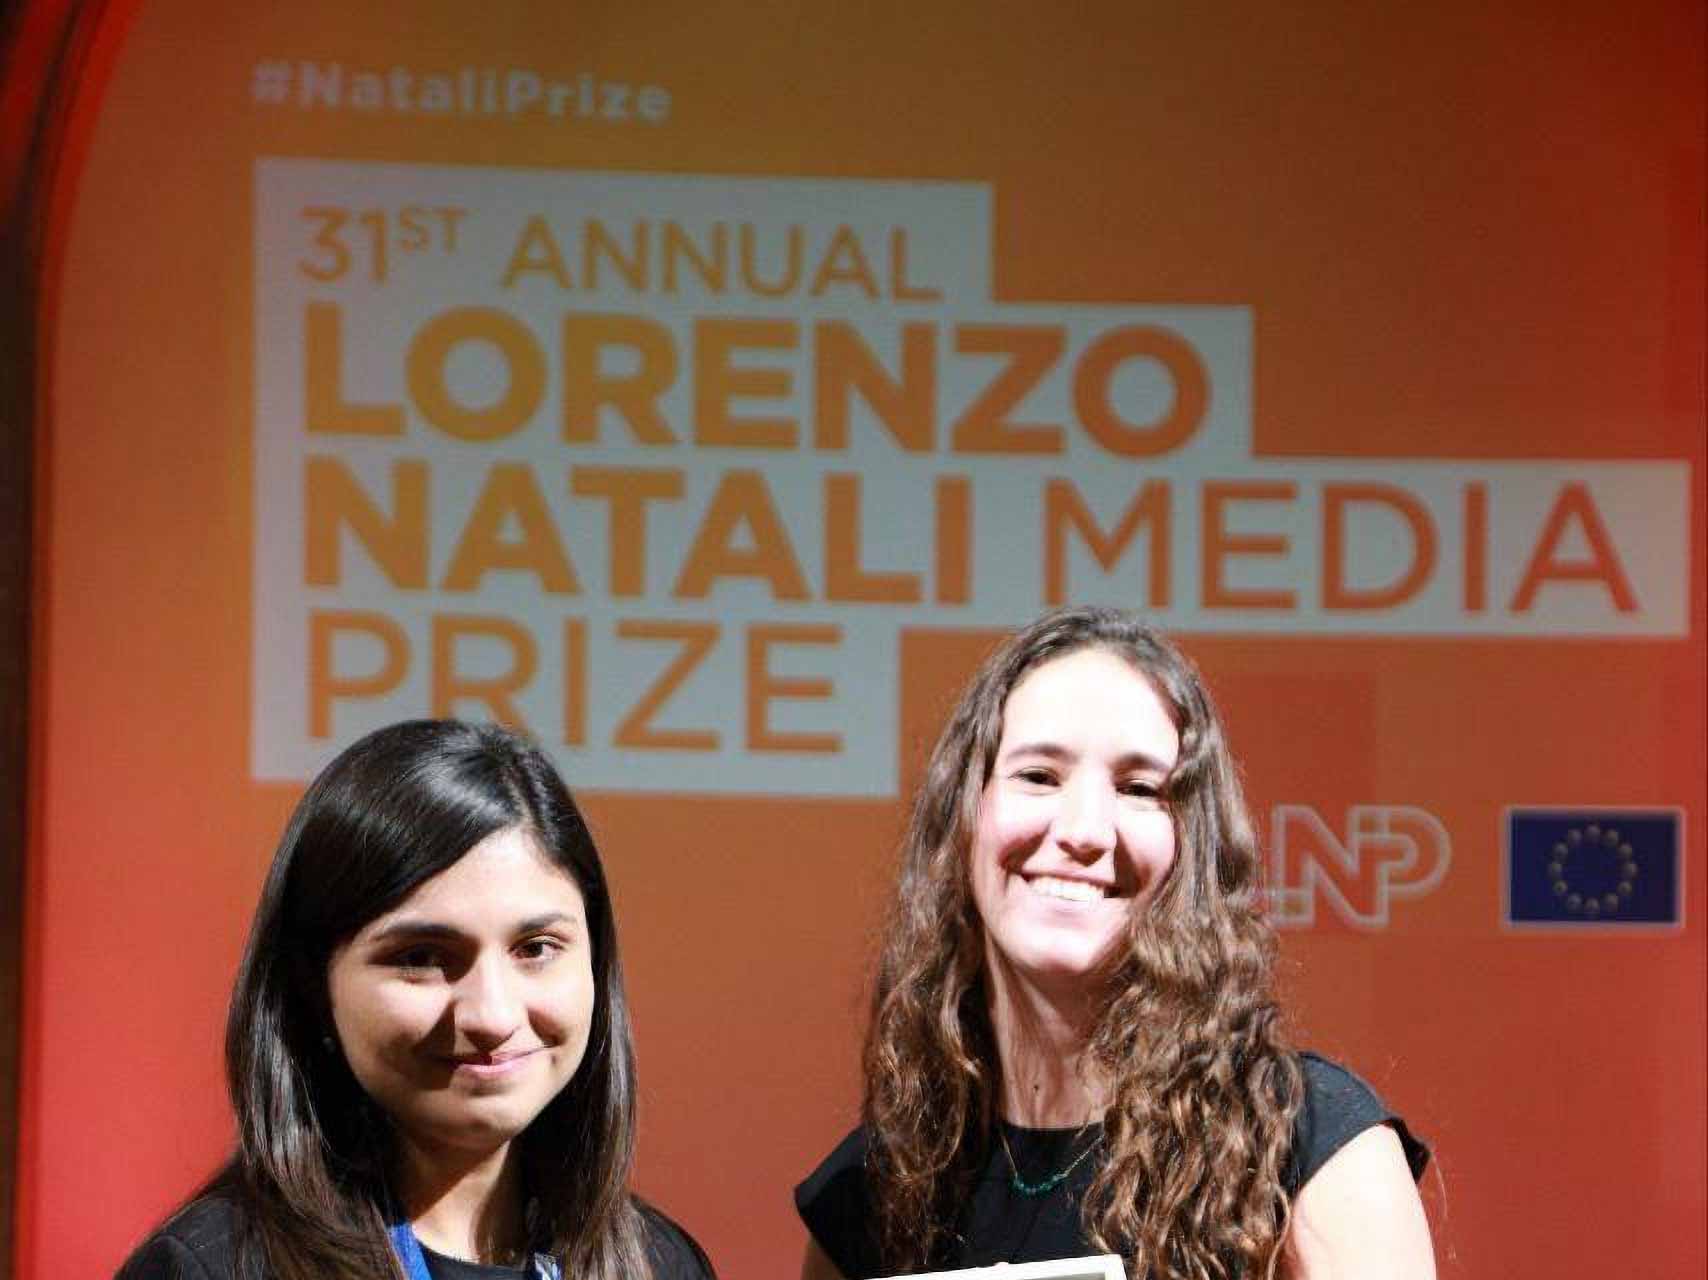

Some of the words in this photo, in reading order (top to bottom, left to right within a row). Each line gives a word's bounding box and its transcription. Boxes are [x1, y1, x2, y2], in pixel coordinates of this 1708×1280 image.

[252, 61, 673, 121] #NataliPrize
[501, 213, 943, 303] ANNUAL
[303, 301, 1212, 457] LORENZO
[303, 454, 972, 607] NATALI
[1044, 477, 1640, 615] MEDIA
[309, 611, 844, 753] PRIZE
